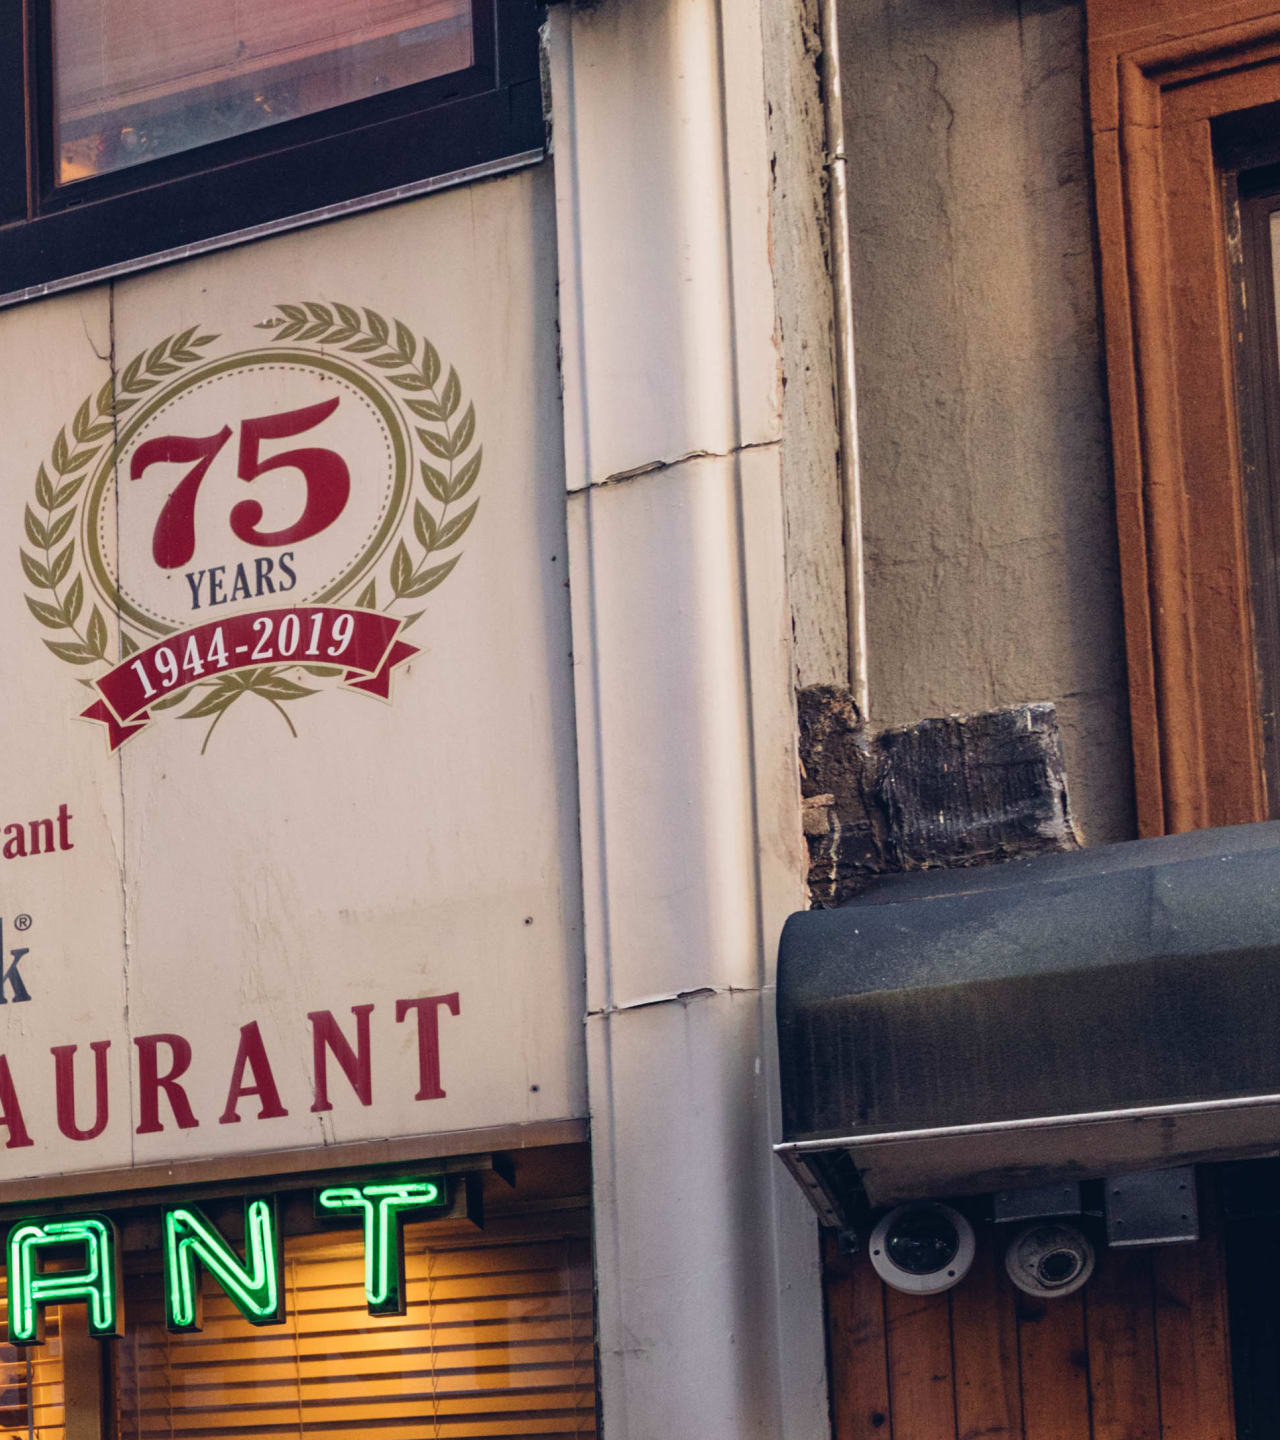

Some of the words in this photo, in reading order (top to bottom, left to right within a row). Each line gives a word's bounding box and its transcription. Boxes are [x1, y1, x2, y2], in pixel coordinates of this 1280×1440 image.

[130, 396, 351, 569] 75
[185, 552, 297, 611] YEARS
[129, 612, 355, 699] 1944-2019
